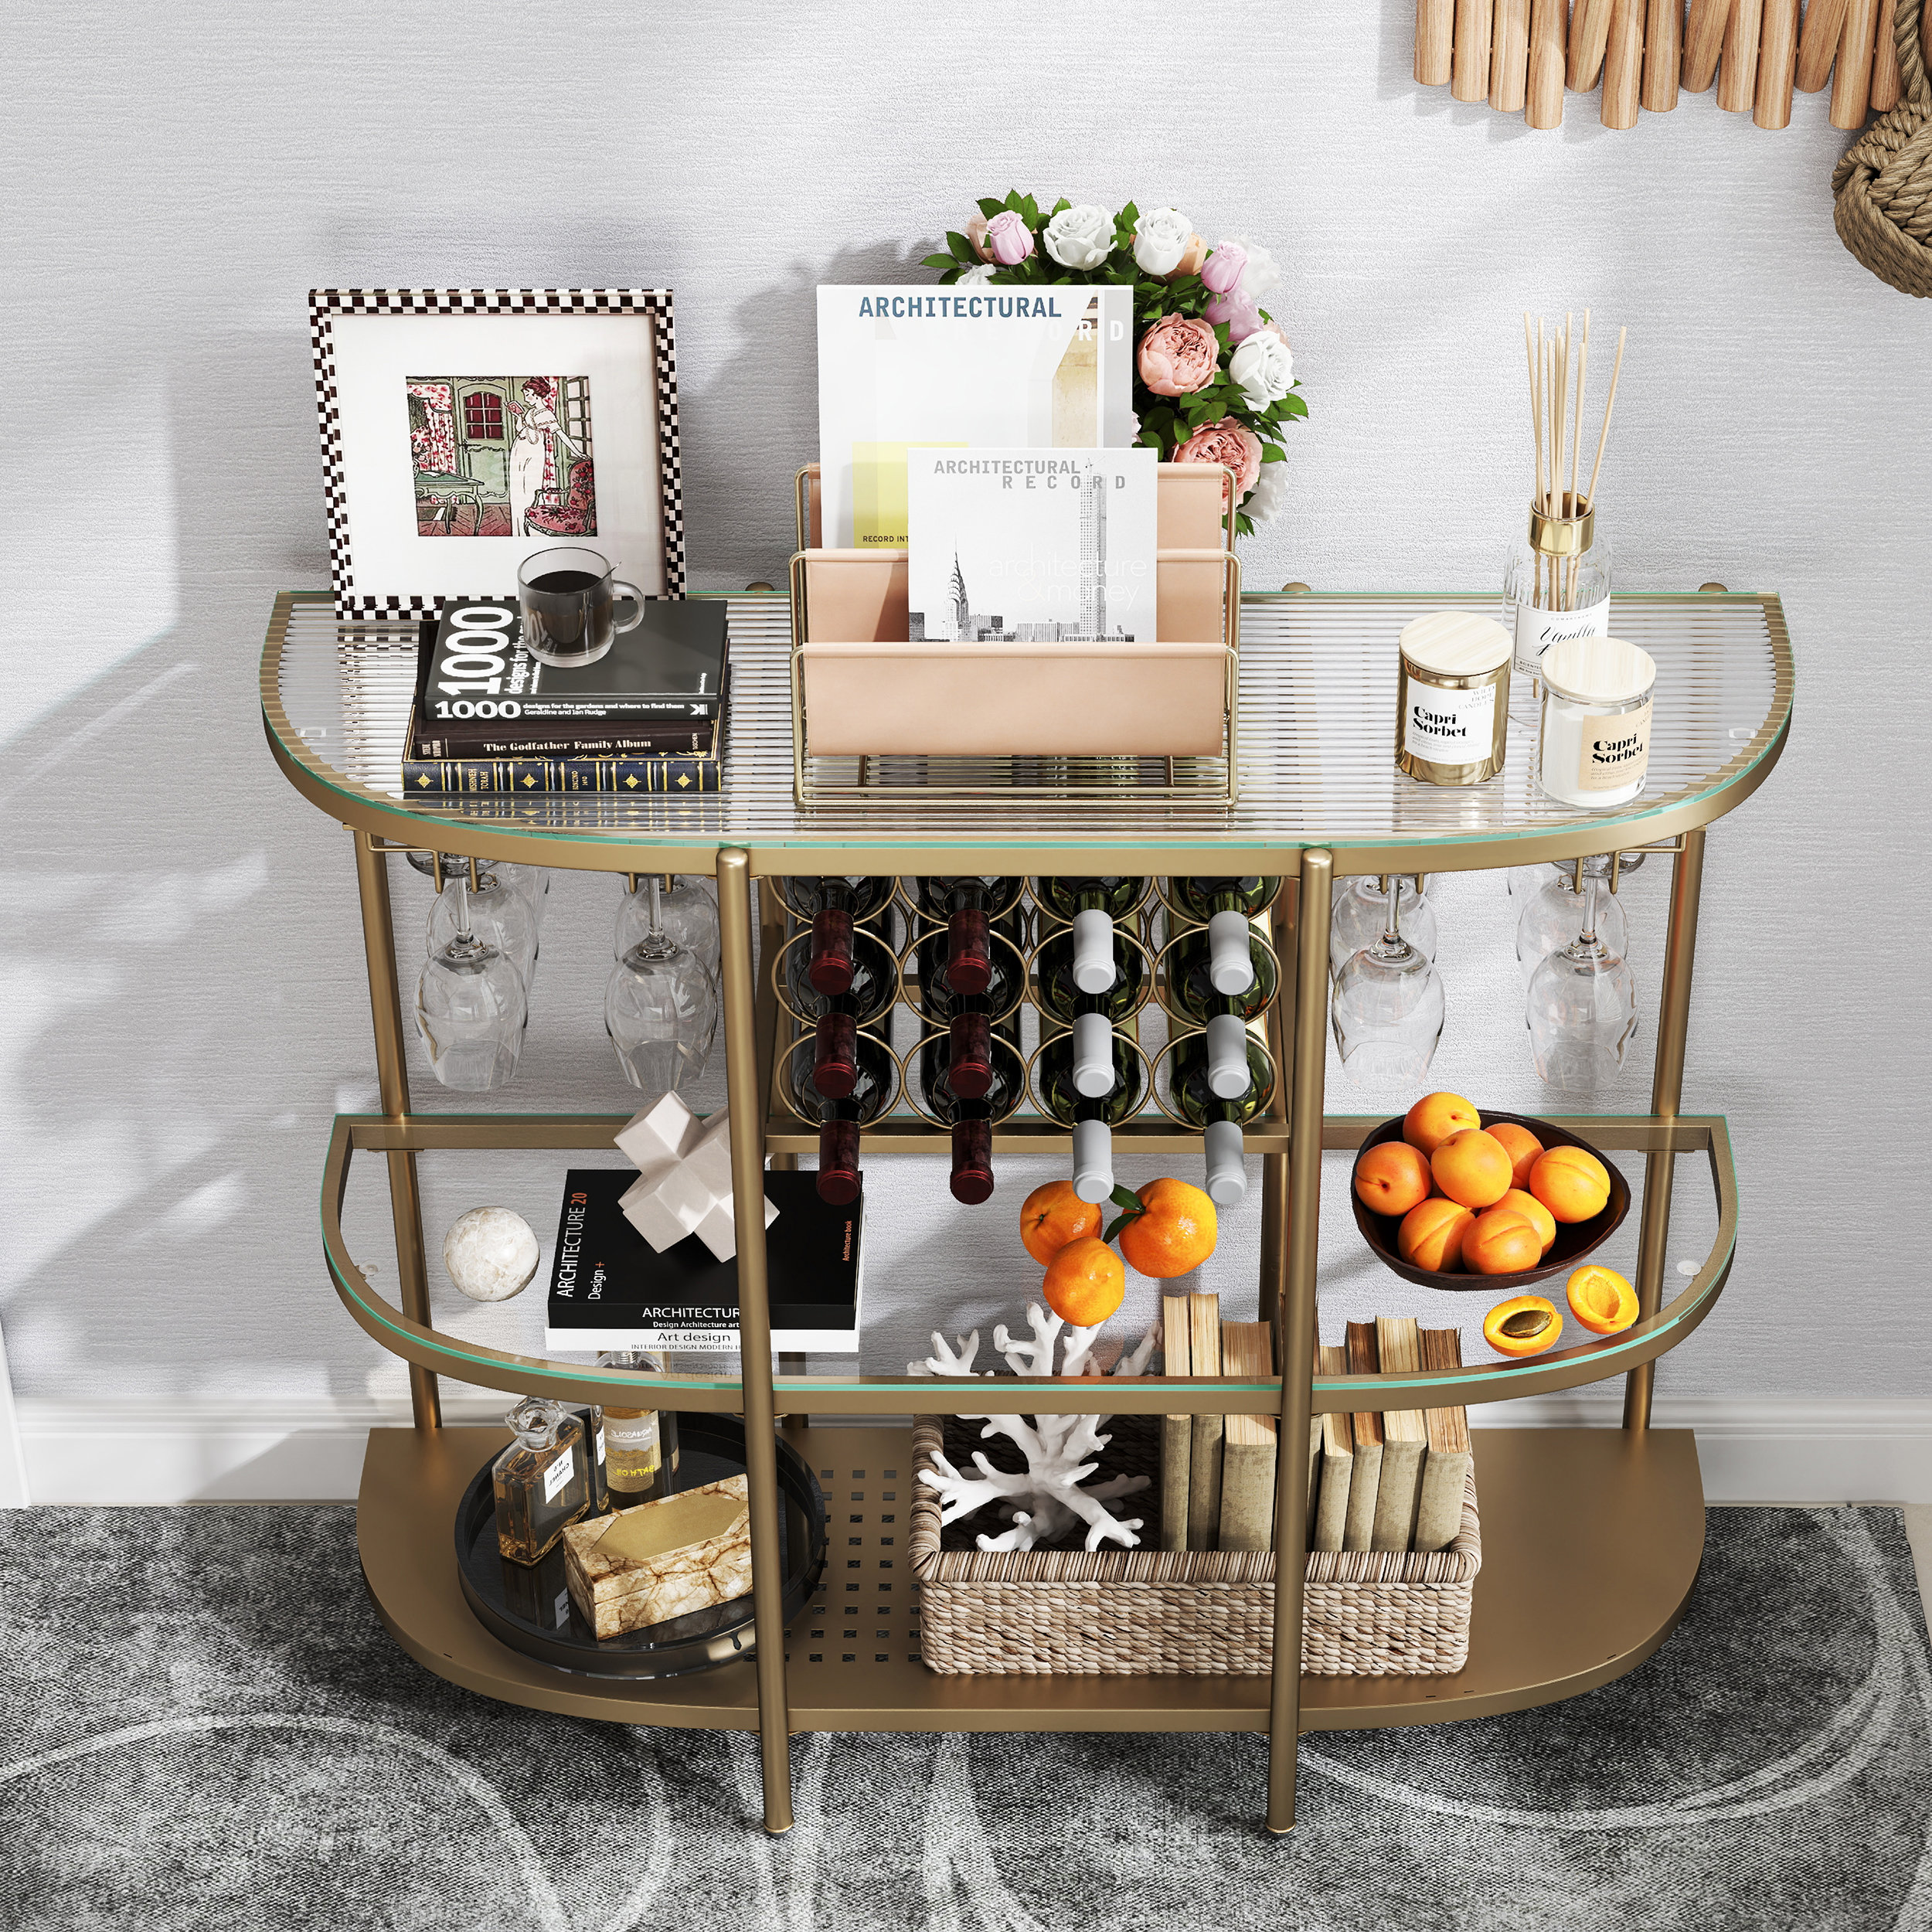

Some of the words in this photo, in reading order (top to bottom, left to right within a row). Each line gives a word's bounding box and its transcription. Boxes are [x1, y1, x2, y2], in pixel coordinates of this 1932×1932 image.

[859, 297, 1062, 318] ARCHITECTURAL
[934, 460, 1081, 474] ARCHITECTURAL
[1002, 475, 1126, 489] RECORD
[989, 542, 1147, 577] architecture
[437, 607, 513, 696] 1000
[509, 650, 529, 662] for
[504, 662, 530, 694] designs
[435, 700, 521, 719] 1000
[1413, 706, 1457, 725] Capri
[1413, 718, 1466, 736] Sorbet
[483, 743, 507, 751] The
[510, 742, 570, 751] Godfather
[574, 740, 613, 750] Family
[615, 740, 651, 749] Album
[1593, 733, 1637, 752] Capri
[1592, 742, 1643, 764] Sorbet
[480, 771, 489, 790] TORAH
[570, 1192, 587, 1205] 20
[844, 1220, 852, 1232] book
[556, 1207, 586, 1298] ARCHITECTURE
[842, 1233, 852, 1261] Architecture
[587, 1270, 607, 1300] Design
[658, 1332, 679, 1342] Art
[683, 1332, 730, 1344] design
